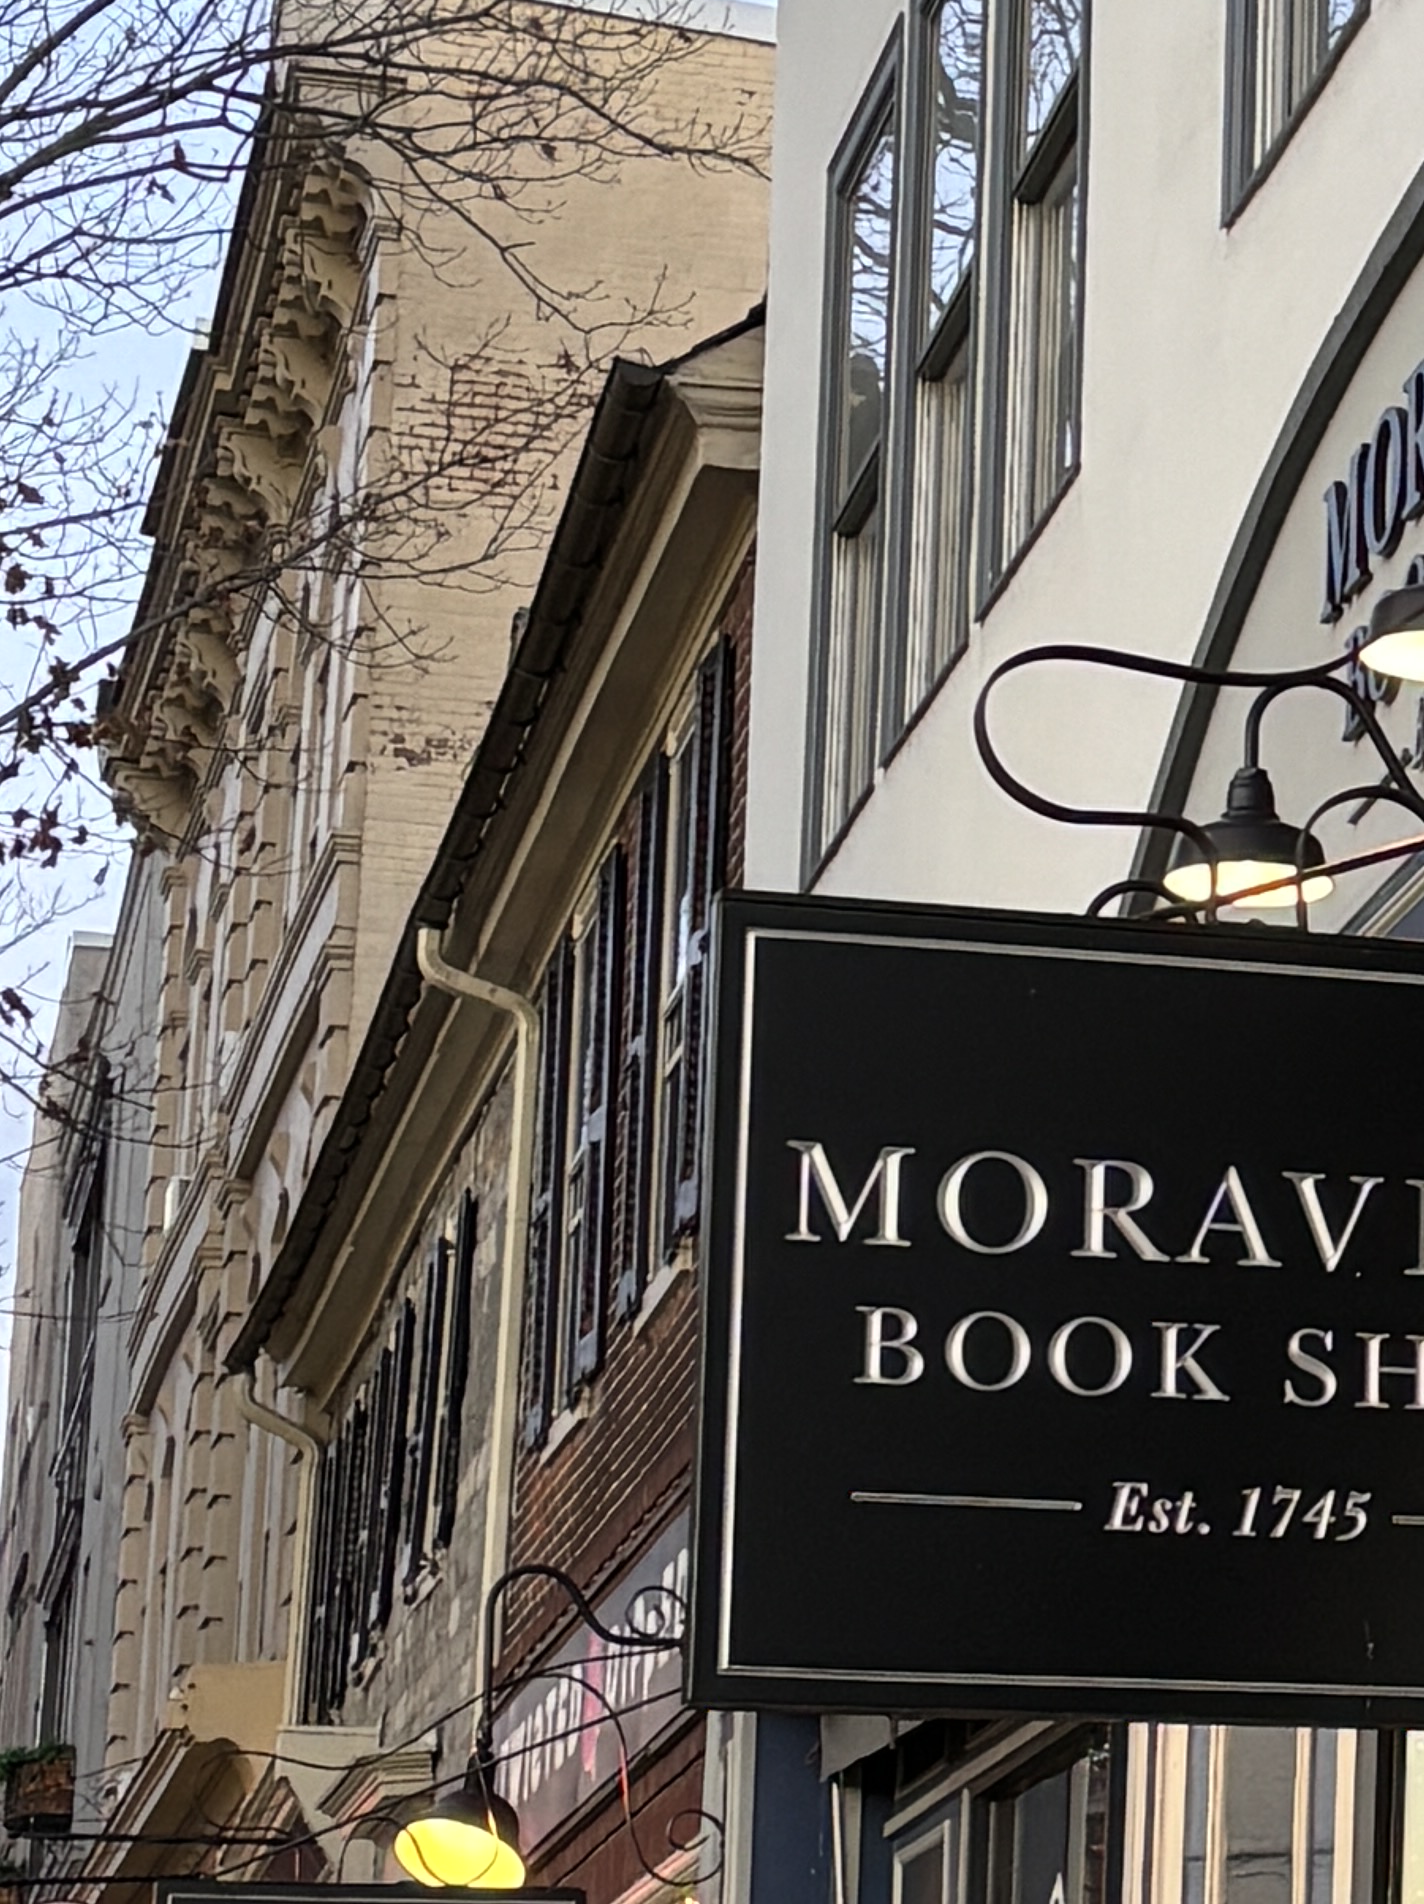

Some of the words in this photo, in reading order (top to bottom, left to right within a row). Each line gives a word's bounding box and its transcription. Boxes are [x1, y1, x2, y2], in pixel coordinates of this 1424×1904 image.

[852, 1303, 1231, 1403] BOOK
[1103, 1480, 1211, 1538] Est.
[1230, 1484, 1373, 1543] 1745
